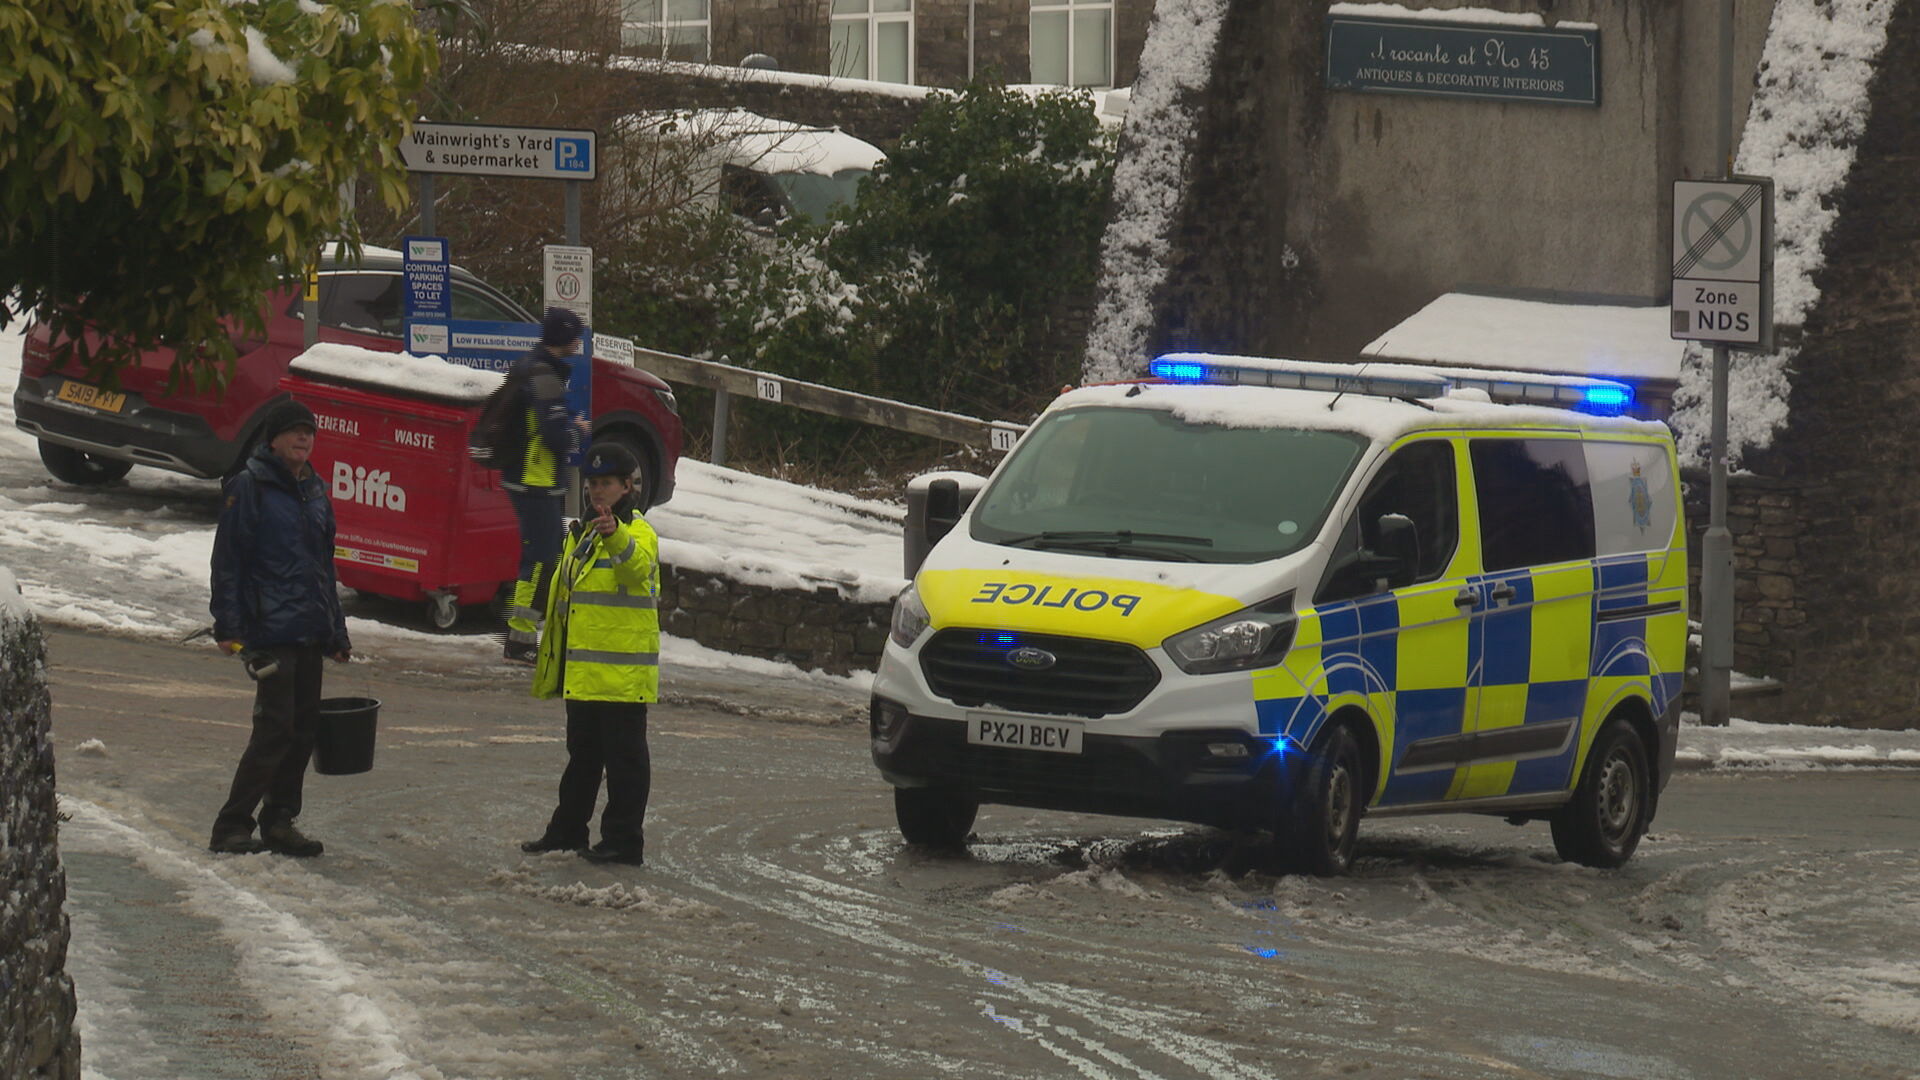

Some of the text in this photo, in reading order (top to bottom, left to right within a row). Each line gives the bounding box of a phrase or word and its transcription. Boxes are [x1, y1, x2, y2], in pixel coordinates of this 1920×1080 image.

[1458, 45, 1476, 65] at
[1484, 38, 1520, 68] No
[1529, 48, 1551, 70] 45
[1356, 67, 1564, 92] ANTIQUES & DECORATIVE INTERIORS
[412, 131, 553, 151] Wainwright's Yard
[425, 150, 539, 169] & supermarket
[559, 141, 577, 168] P
[405, 263, 447, 274] CONTRACT
[409, 272, 444, 282] PARKING
[412, 281, 443, 291] SPACES
[414, 291, 441, 300] TO LET
[1695, 287, 1738, 305] Zone
[1698, 310, 1750, 332] NDS
[456, 336, 472, 345] LOW
[473, 337, 506, 346] FELLSIDE
[506, 339, 537, 348] CONTRA
[595, 336, 632, 352] RESERVED
[763, 382, 775, 399] 10
[395, 428, 435, 449] WASTE
[998, 432, 1010, 449] 11
[332, 460, 407, 513] Biffa
[980, 720, 1070, 748] PX21 BCV
